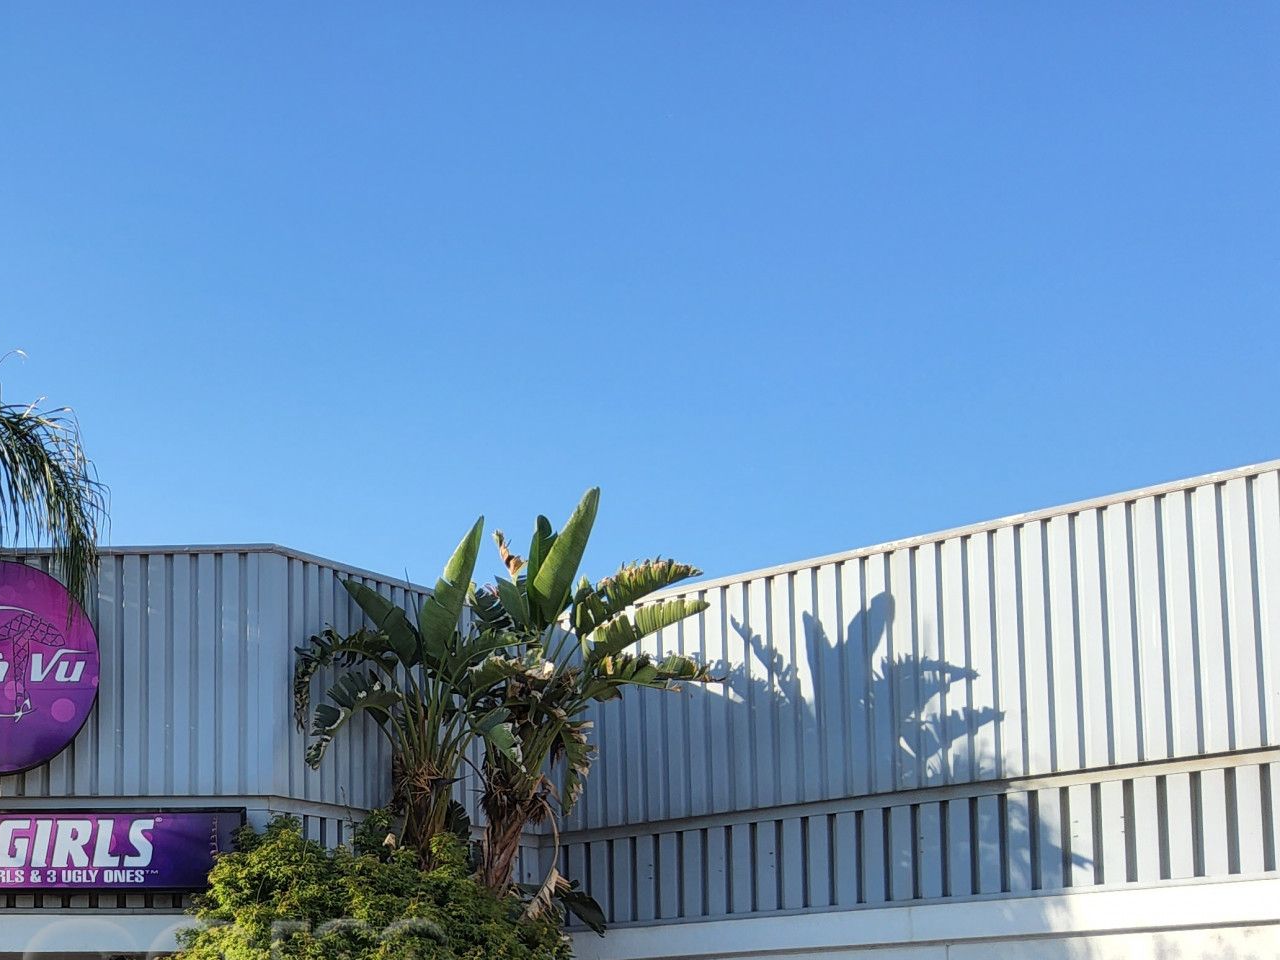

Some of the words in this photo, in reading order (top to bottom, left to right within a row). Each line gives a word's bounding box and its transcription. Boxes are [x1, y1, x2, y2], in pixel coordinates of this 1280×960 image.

[30, 648, 93, 683] Vu
[29, 869, 42, 884] &
[46, 869, 57, 884] 3
[61, 869, 98, 884] UGLY
